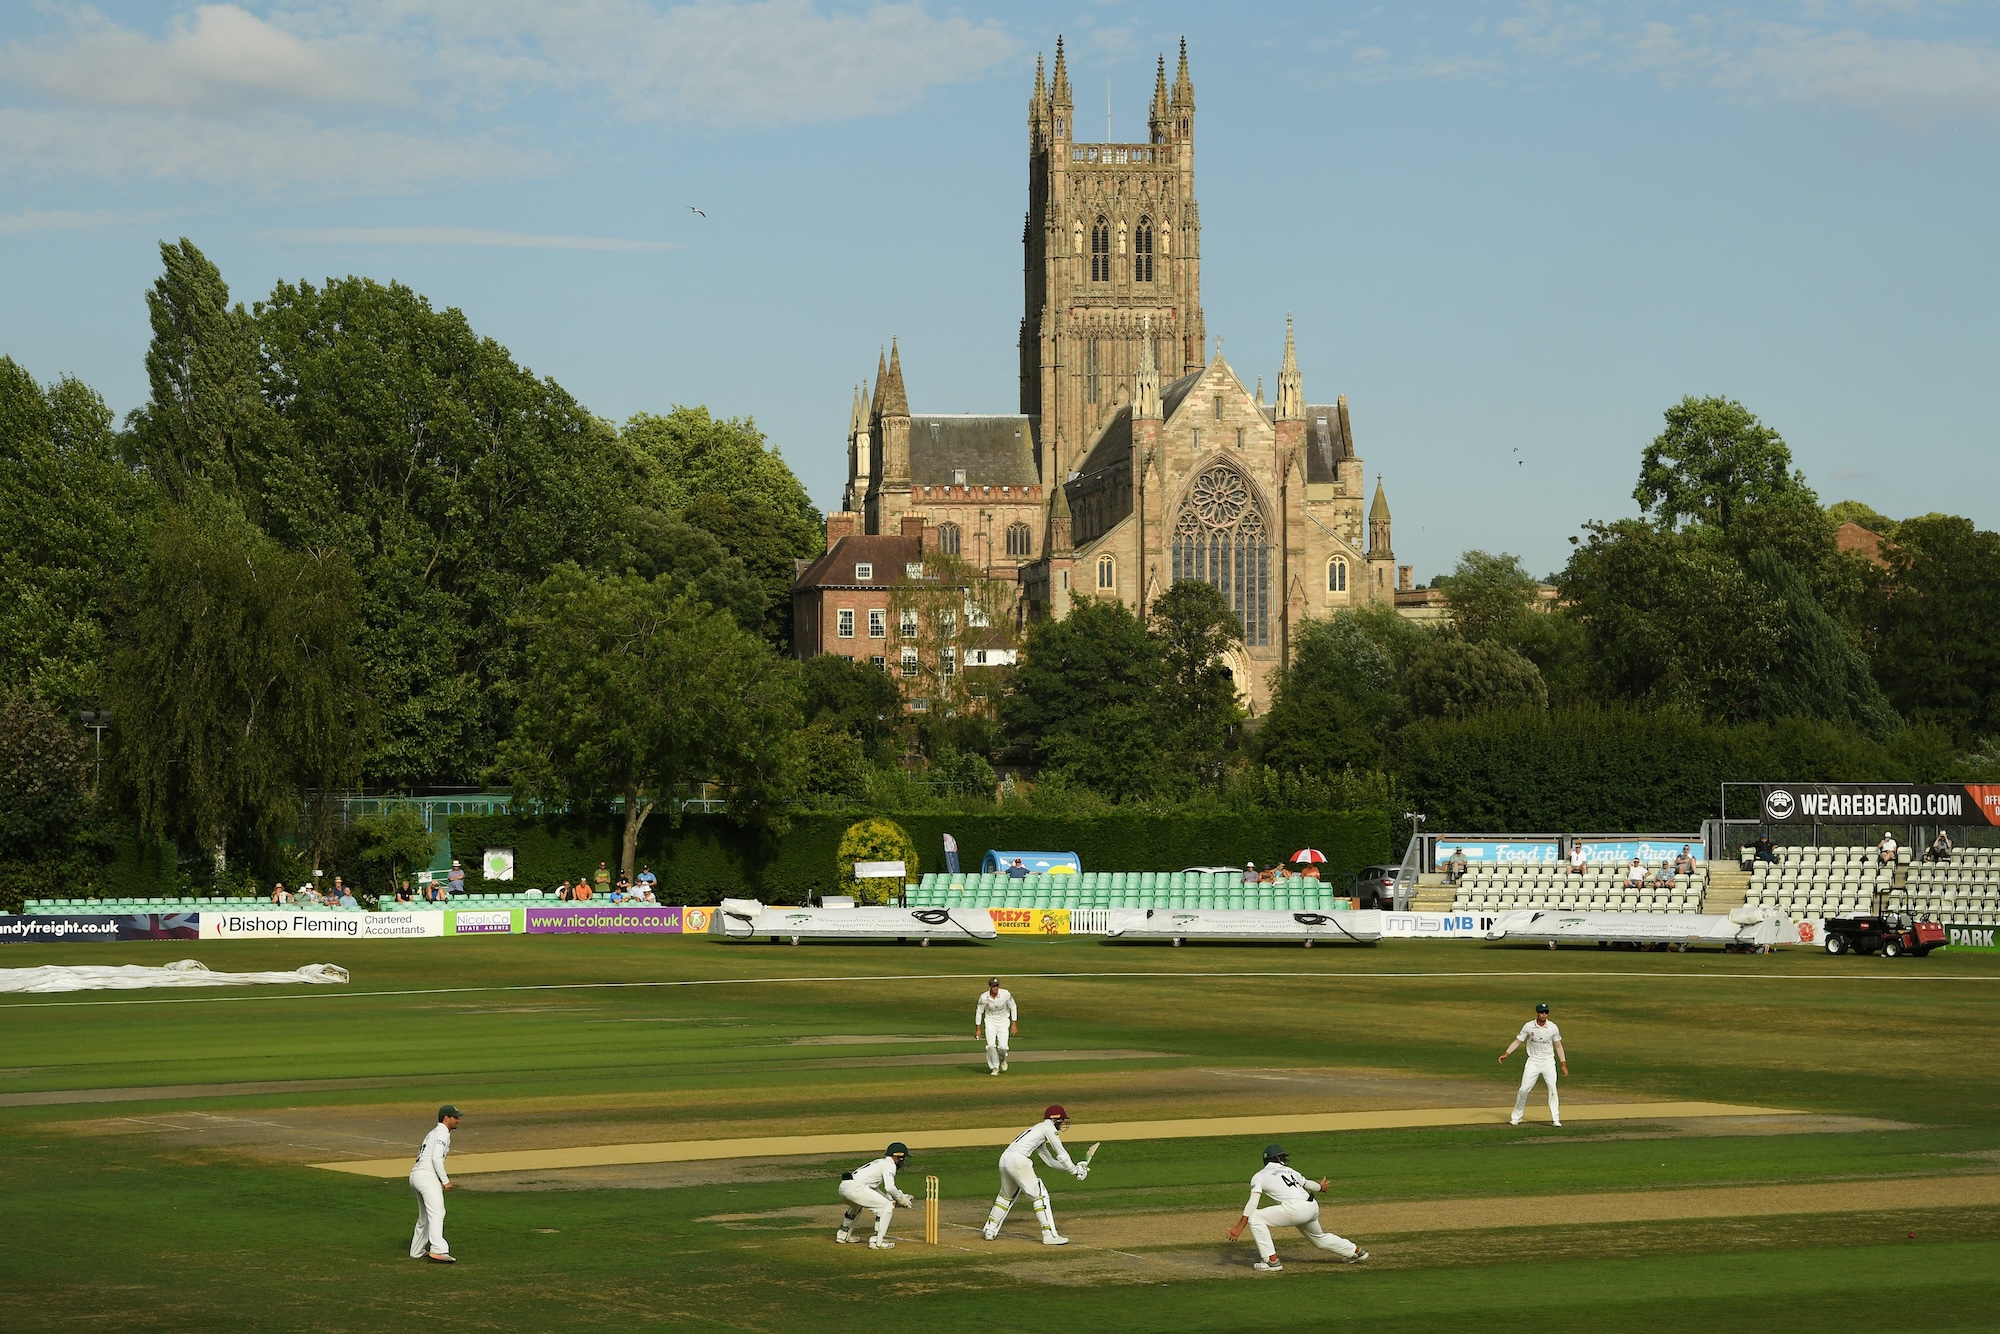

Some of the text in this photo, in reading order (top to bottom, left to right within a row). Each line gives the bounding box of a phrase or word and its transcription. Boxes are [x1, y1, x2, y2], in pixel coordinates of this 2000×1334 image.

[1800, 793, 1963, 816] WEAREBEARD.COM
[1496, 843, 1677, 861] Food & Picnic Area
[229, 916, 358, 935] Bishop Fleming
[365, 915, 412, 925] Chartered
[457, 914, 509, 924] Nicol&Co
[531, 913, 679, 928] www.nicolandco.co.uk
[1444, 917, 1474, 931] MB
[365, 925, 426, 935] Accountants
[1950, 928, 1996, 947] PARK
